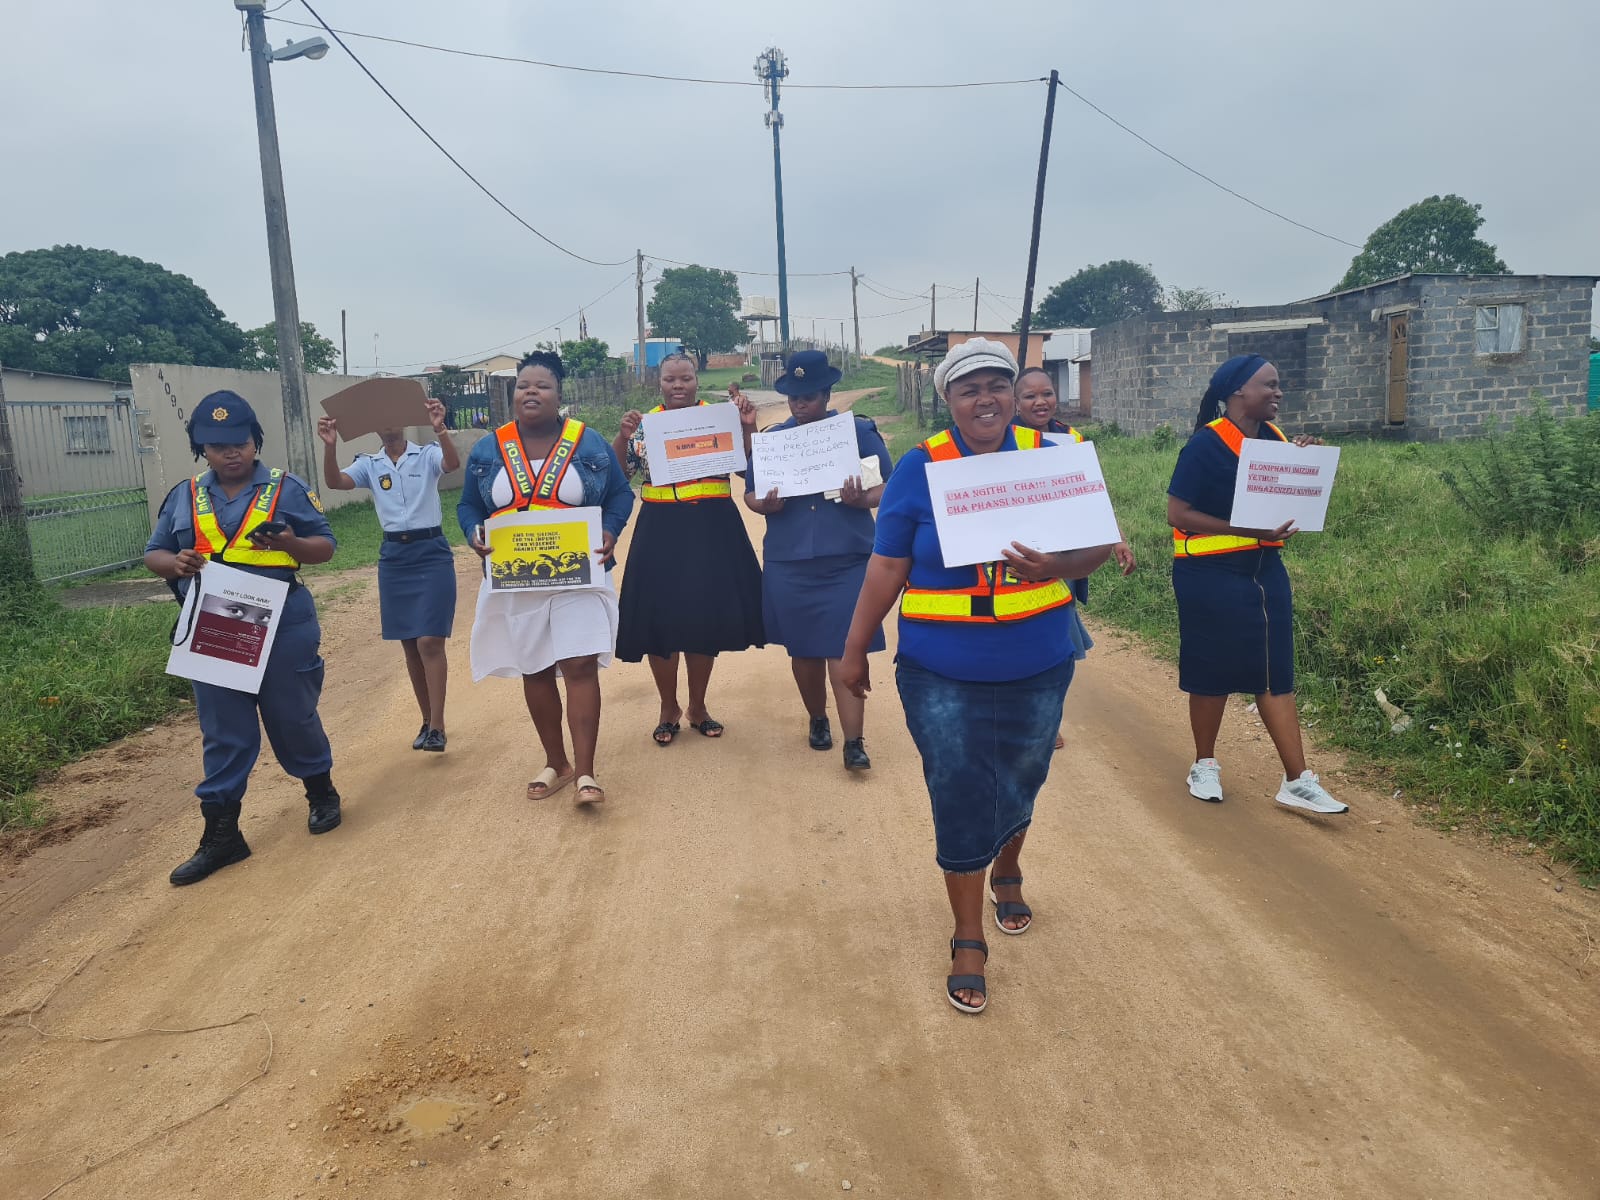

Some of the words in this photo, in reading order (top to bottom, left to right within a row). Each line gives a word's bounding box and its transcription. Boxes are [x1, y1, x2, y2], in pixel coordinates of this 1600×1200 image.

[754, 434, 777, 446] LET
[784, 431, 799, 441] US
[505, 442, 531, 494] POLICE
[946, 490, 970, 501] UMA
[972, 484, 1007, 497] NGITHI
[1051, 473, 1086, 487] NGITHI
[946, 505, 969, 515] CHA
[971, 498, 1010, 512] PHANSI
[1011, 497, 1025, 506] NO
